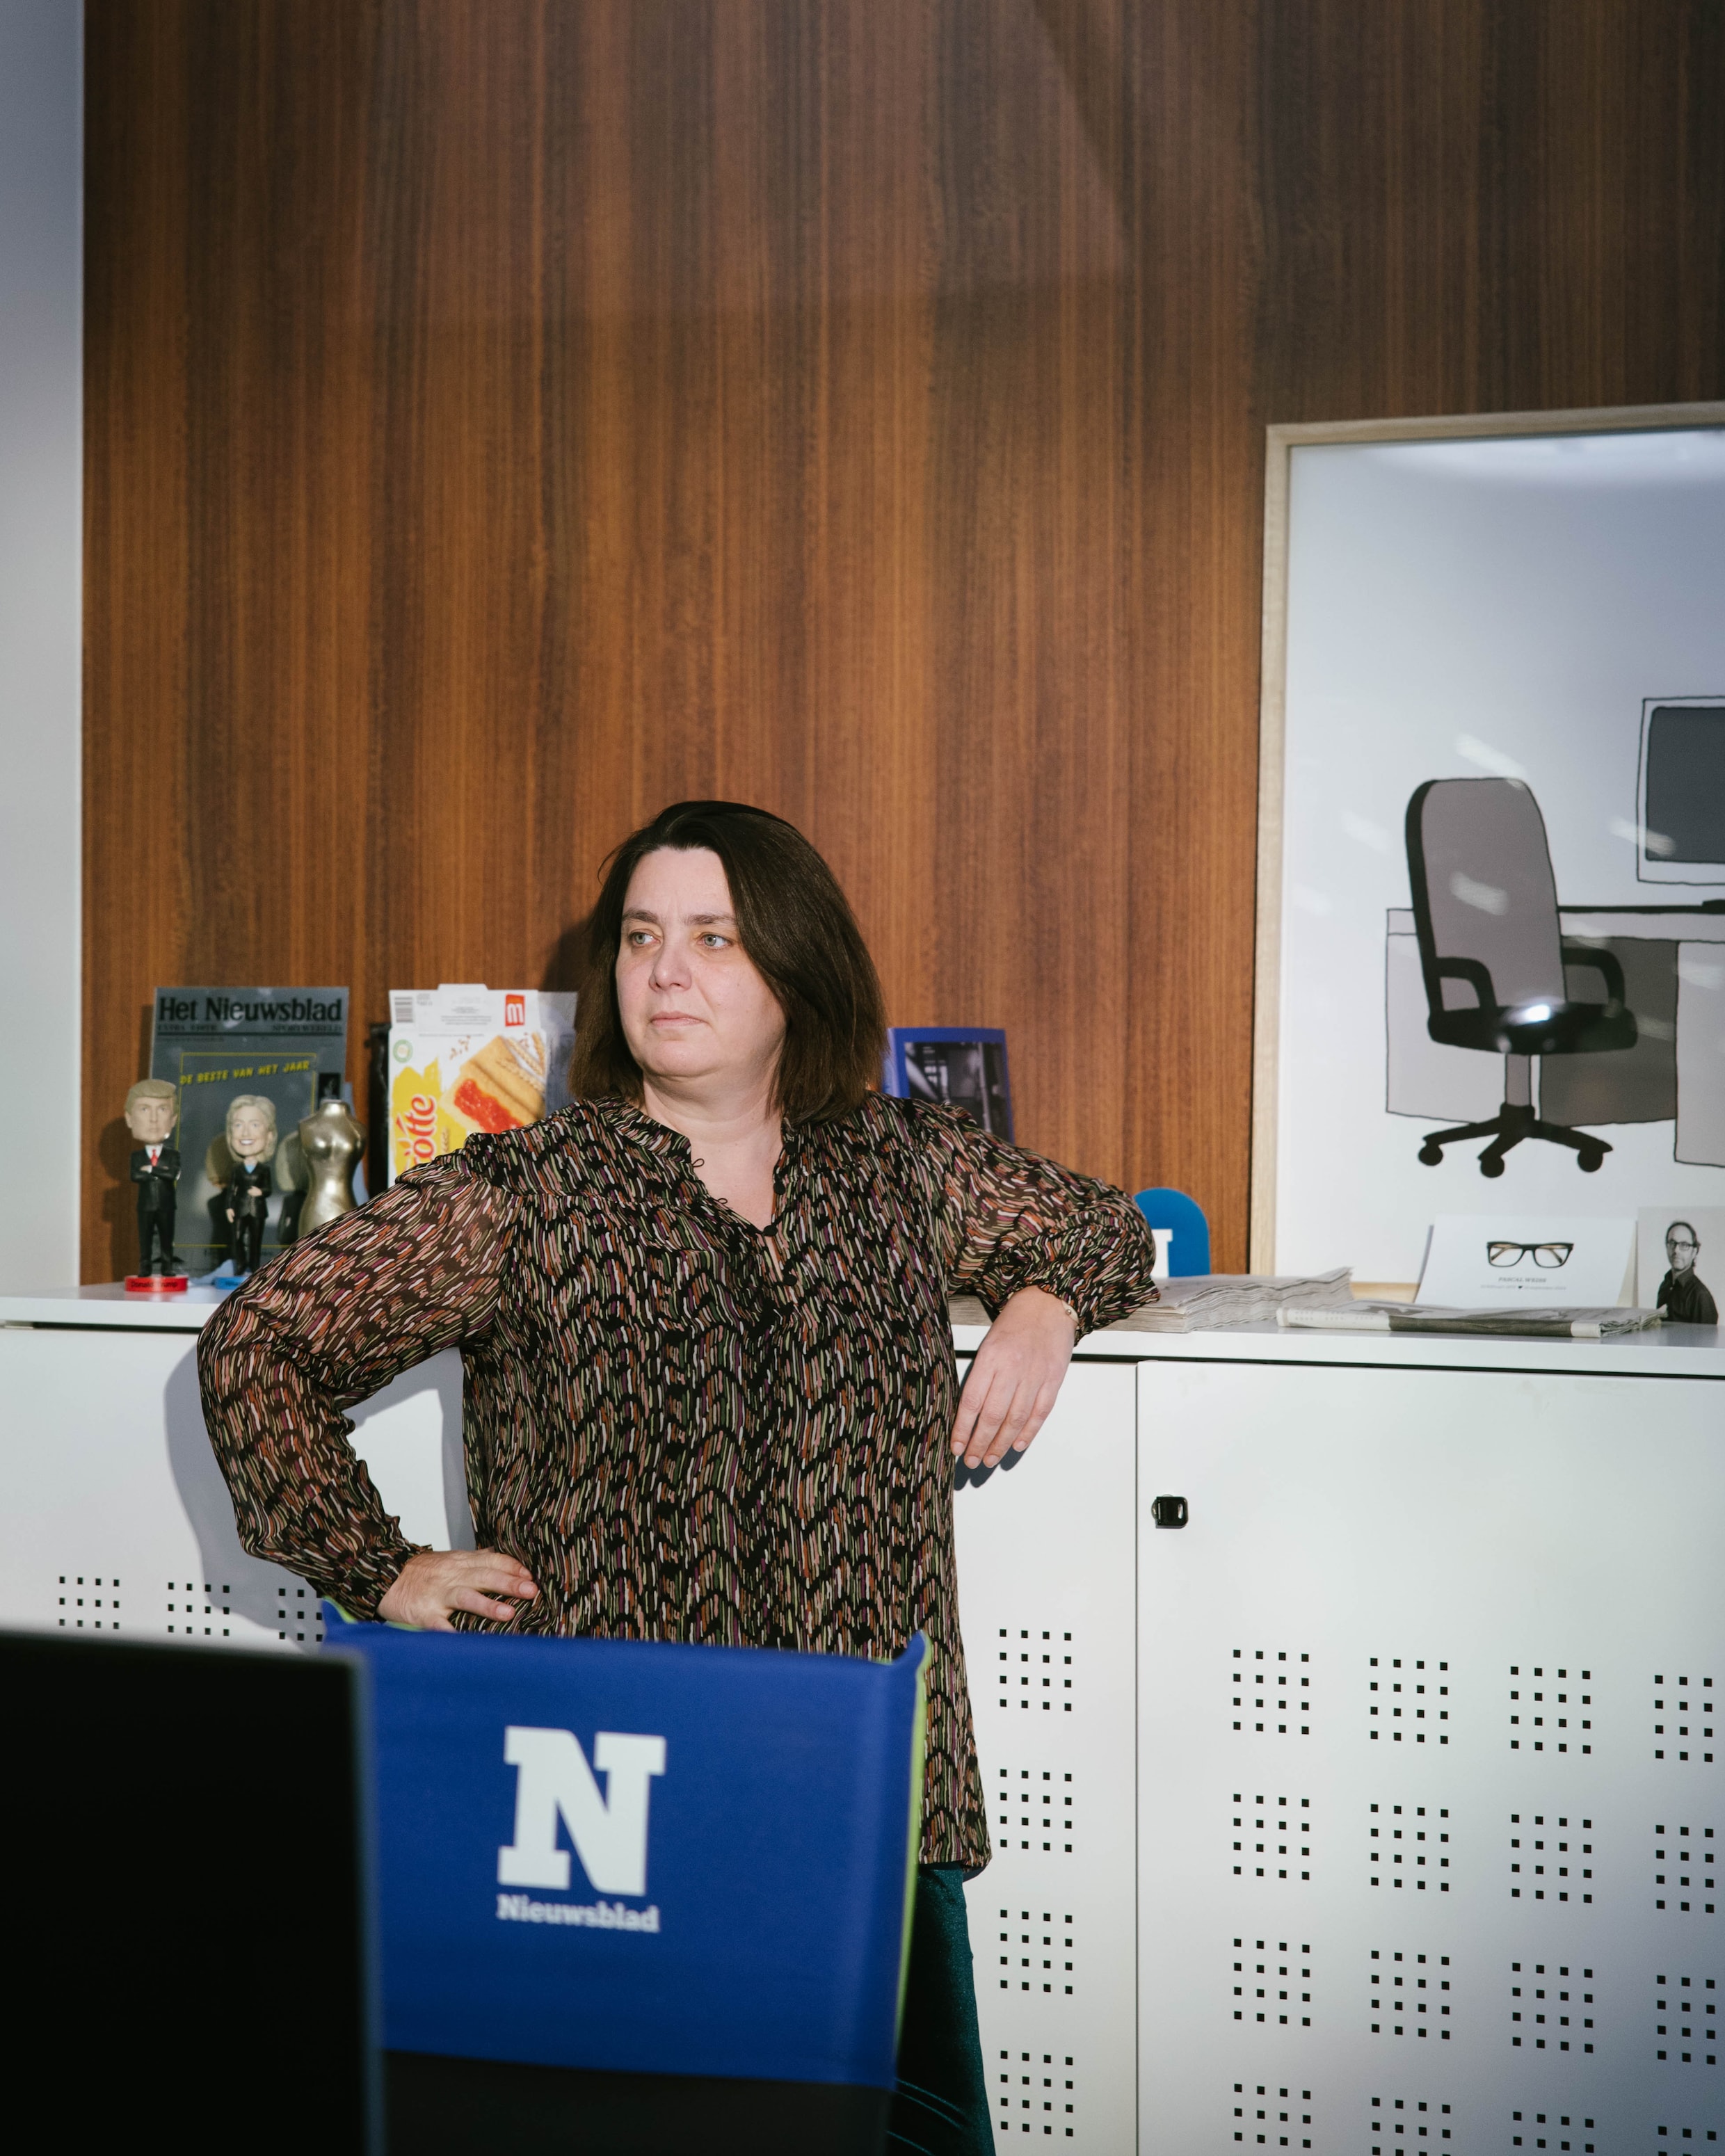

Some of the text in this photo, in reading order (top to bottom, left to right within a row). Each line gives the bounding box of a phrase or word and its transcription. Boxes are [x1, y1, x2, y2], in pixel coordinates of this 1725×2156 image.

[159, 997, 342, 1022] Het Nieuwsblad
[179, 1060, 310, 1084] DE BESTE VAN HET JAAR
[158, 1280, 178, 1289] rump
[497, 1725, 666, 1897] N
[496, 1893, 660, 1933] Nieuwsblad
